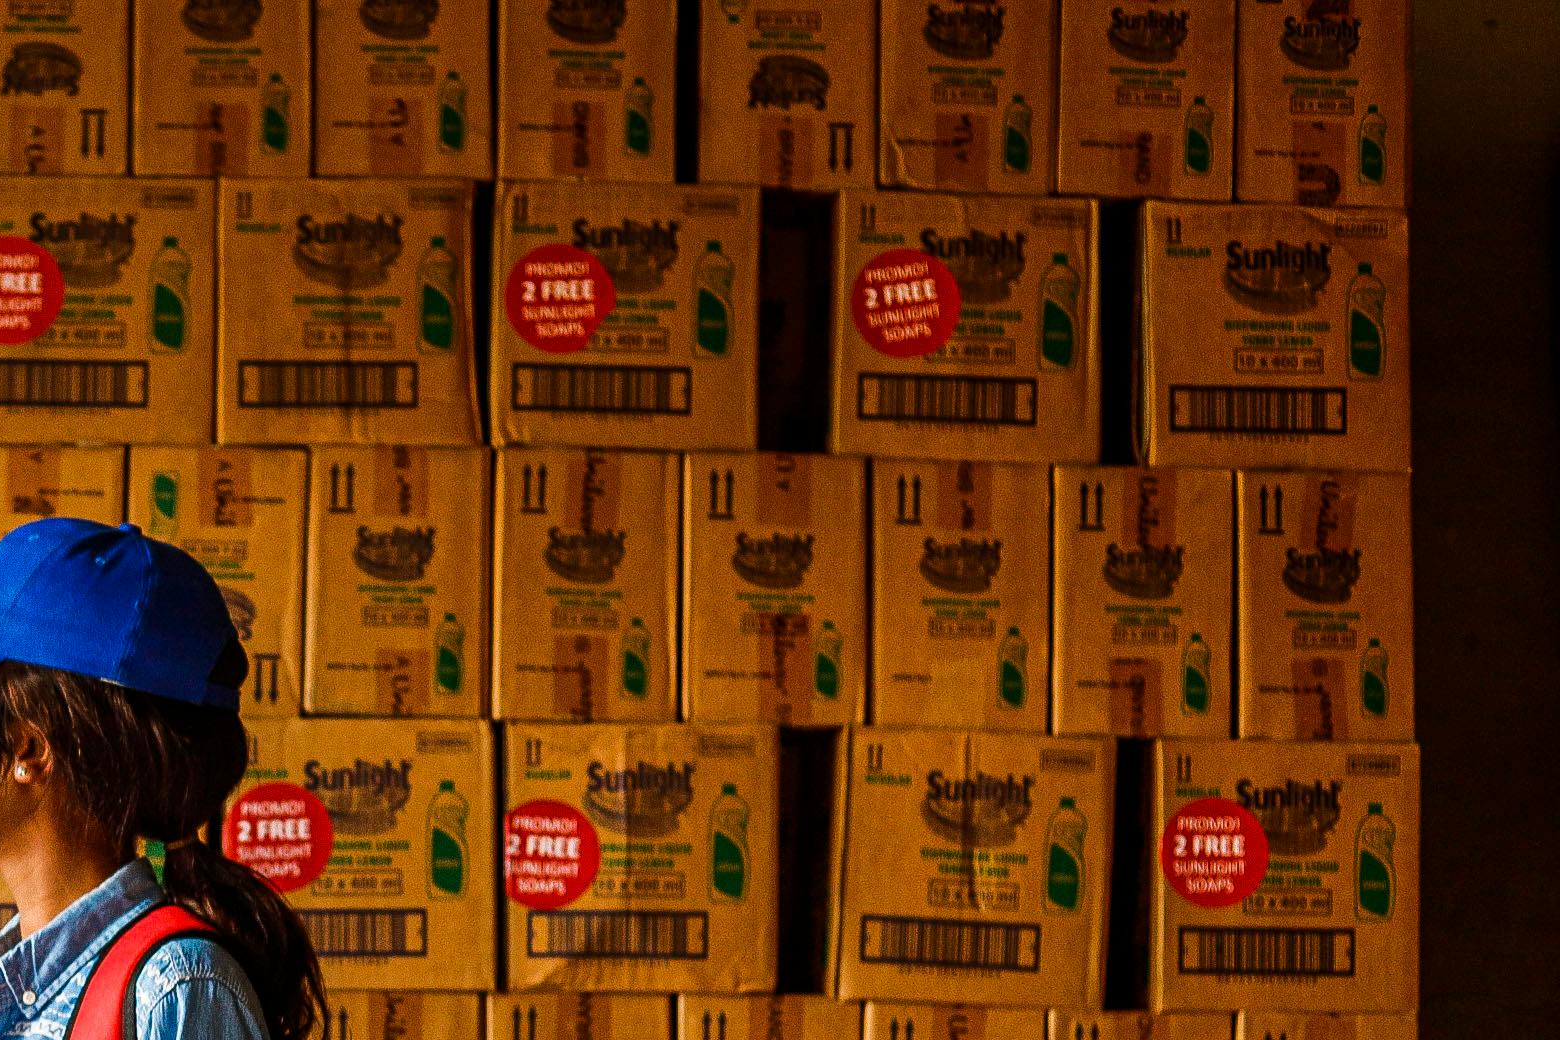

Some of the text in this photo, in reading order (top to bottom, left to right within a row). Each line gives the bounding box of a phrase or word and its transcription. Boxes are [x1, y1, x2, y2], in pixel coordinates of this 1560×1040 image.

[1110, 7, 1189, 34] Sunlight
[31, 211, 135, 251] Sunlight
[297, 213, 401, 252] Sunlight
[573, 216, 679, 256] Sunlight
[921, 227, 1027, 267] Sunlight
[1227, 240, 1331, 277] Sunlight
[522, 279, 594, 301] 2 FREE
[865, 277, 937, 309] 2 FREE
[305, 759, 412, 797] Sunlight
[587, 760, 696, 800] Sunlight
[926, 770, 1035, 808] Sunlight
[1236, 779, 1341, 818] Sunlight
[237, 818, 311, 842] 2 FREE
[509, 833, 581, 859] 2 FREE
[1173, 834, 1245, 857] 2 FREE
